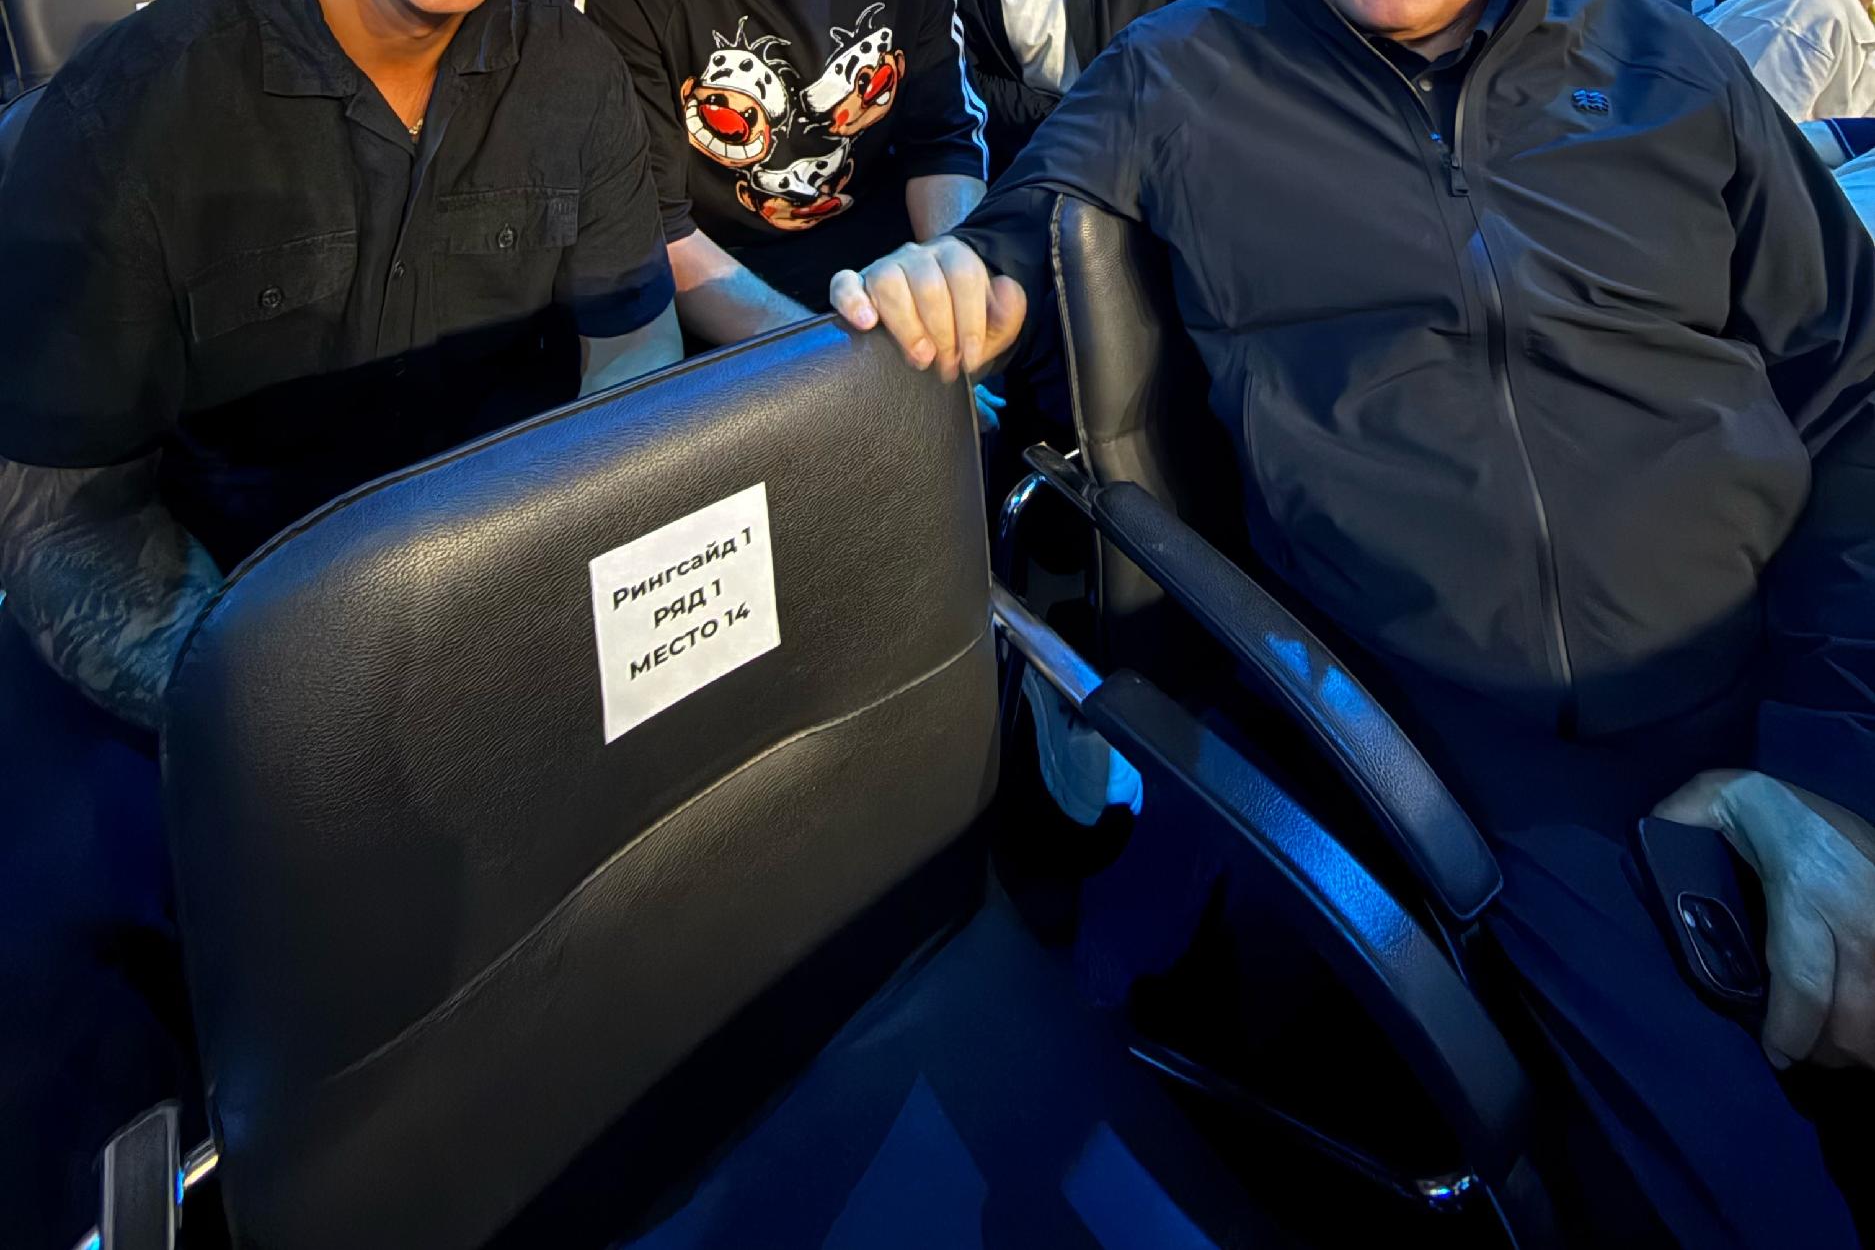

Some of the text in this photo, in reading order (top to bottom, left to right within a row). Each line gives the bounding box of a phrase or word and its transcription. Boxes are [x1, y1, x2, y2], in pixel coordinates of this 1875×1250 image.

[612, 526, 752, 611] Рингсайд 1
[653, 578, 722, 629] РЯД 1
[629, 601, 751, 681] МЕСТО 14
